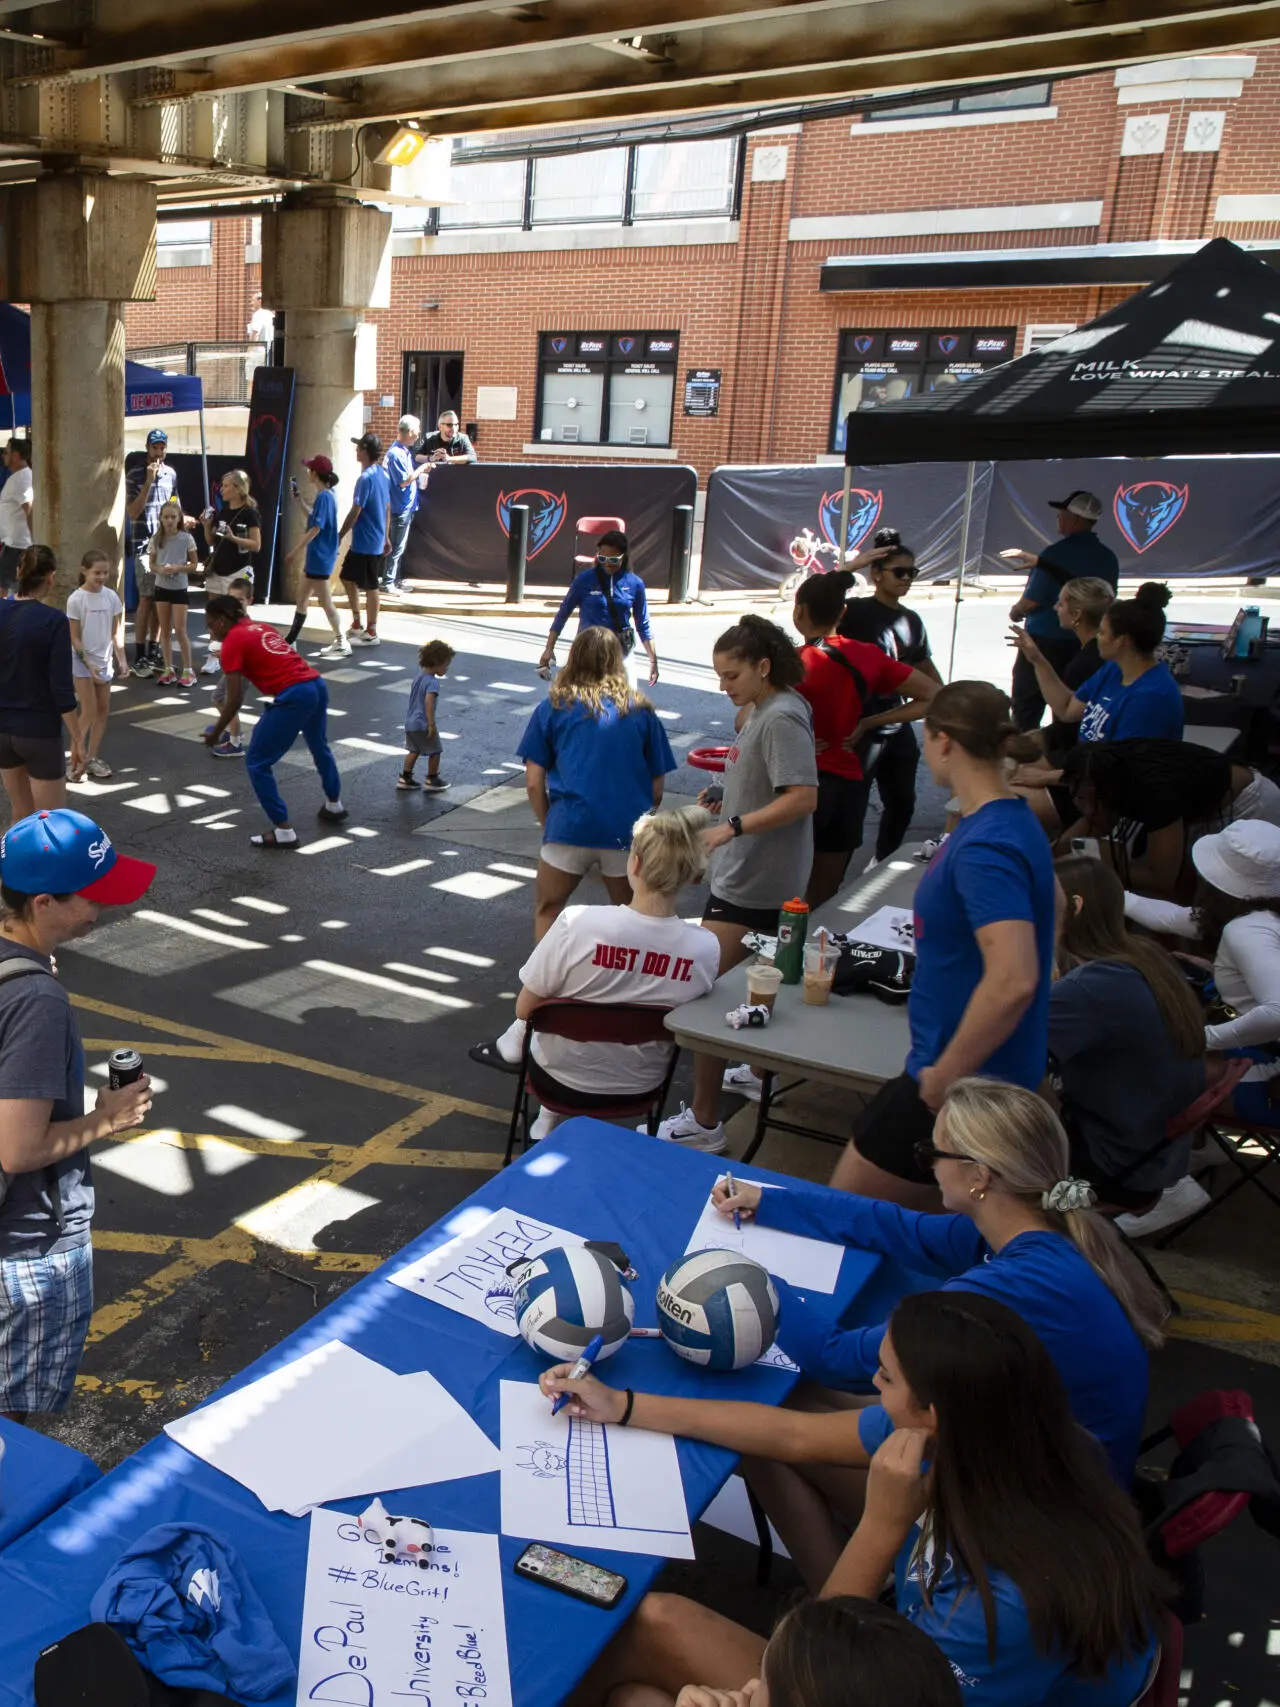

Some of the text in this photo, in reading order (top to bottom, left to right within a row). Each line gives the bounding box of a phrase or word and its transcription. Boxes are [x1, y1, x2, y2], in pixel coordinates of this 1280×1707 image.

[1074, 359, 1142, 372] MILK
[1069, 370, 1280, 381] LOVE WHAT'S REAL.
[130, 391, 174, 411] DEMONS
[778, 925, 793, 944] G
[592, 944, 694, 982] JUST DO IT.
[375, 1548, 460, 1578] Demns!
